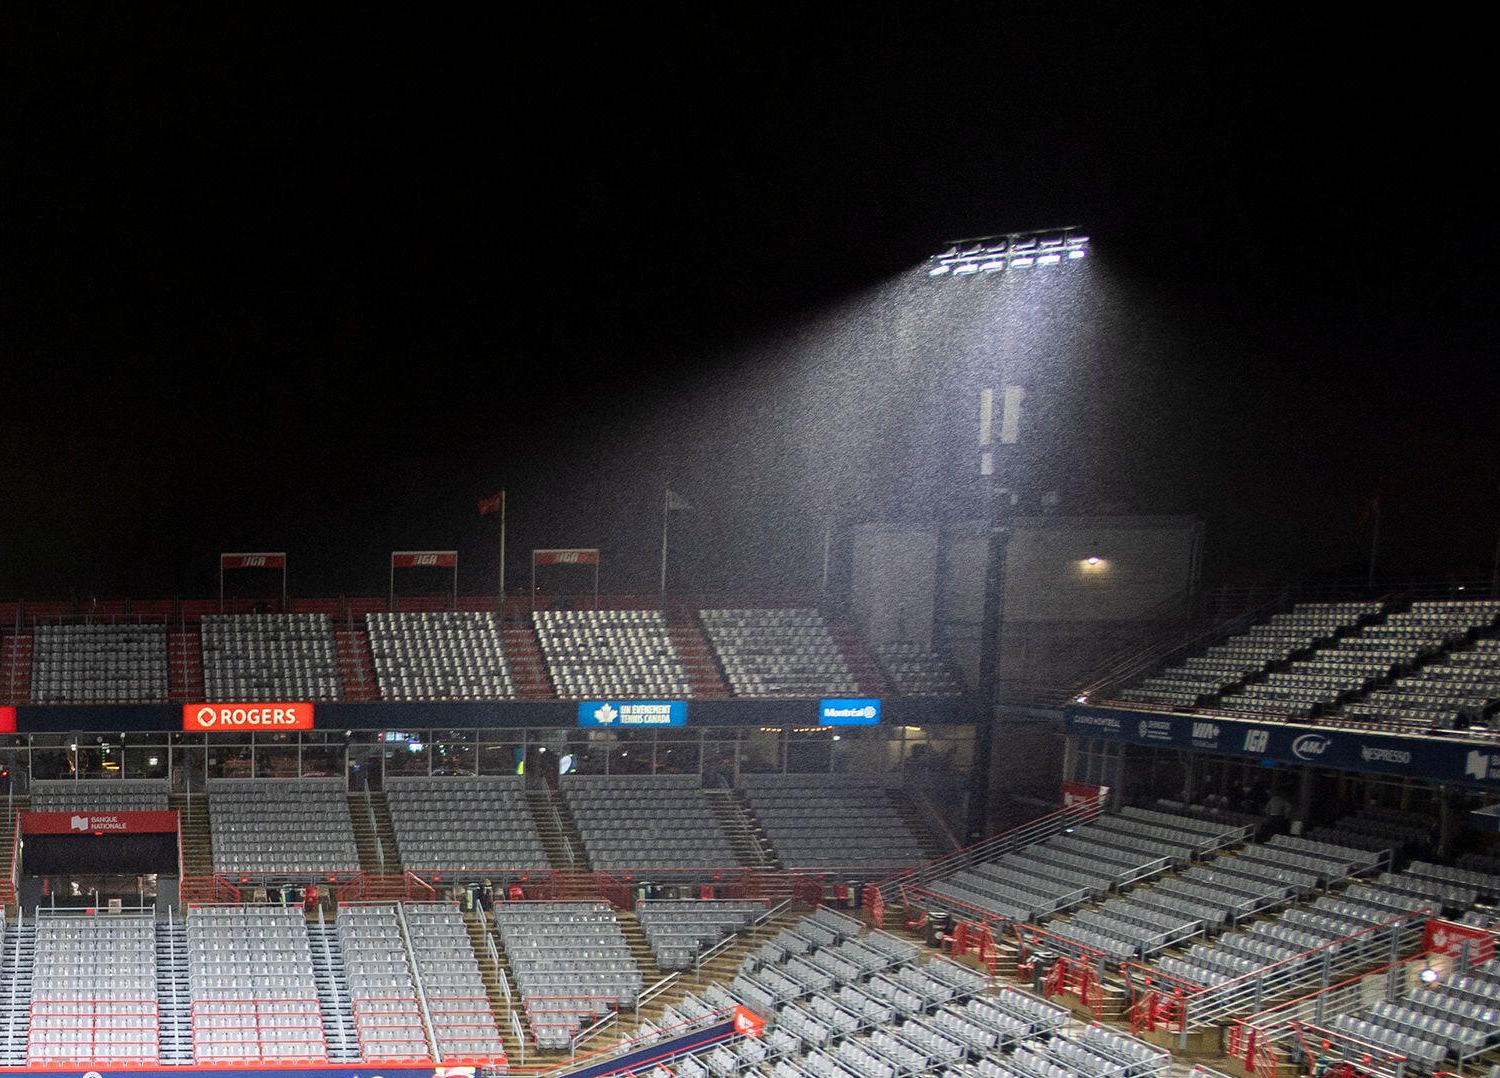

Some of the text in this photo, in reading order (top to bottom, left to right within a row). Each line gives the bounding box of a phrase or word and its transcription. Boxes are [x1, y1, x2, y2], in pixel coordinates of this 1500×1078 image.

[220, 708, 296, 725] ROGERS
[620, 714, 671, 724] TENNIS CANADA
[91, 822, 127, 830] NATIONALE
